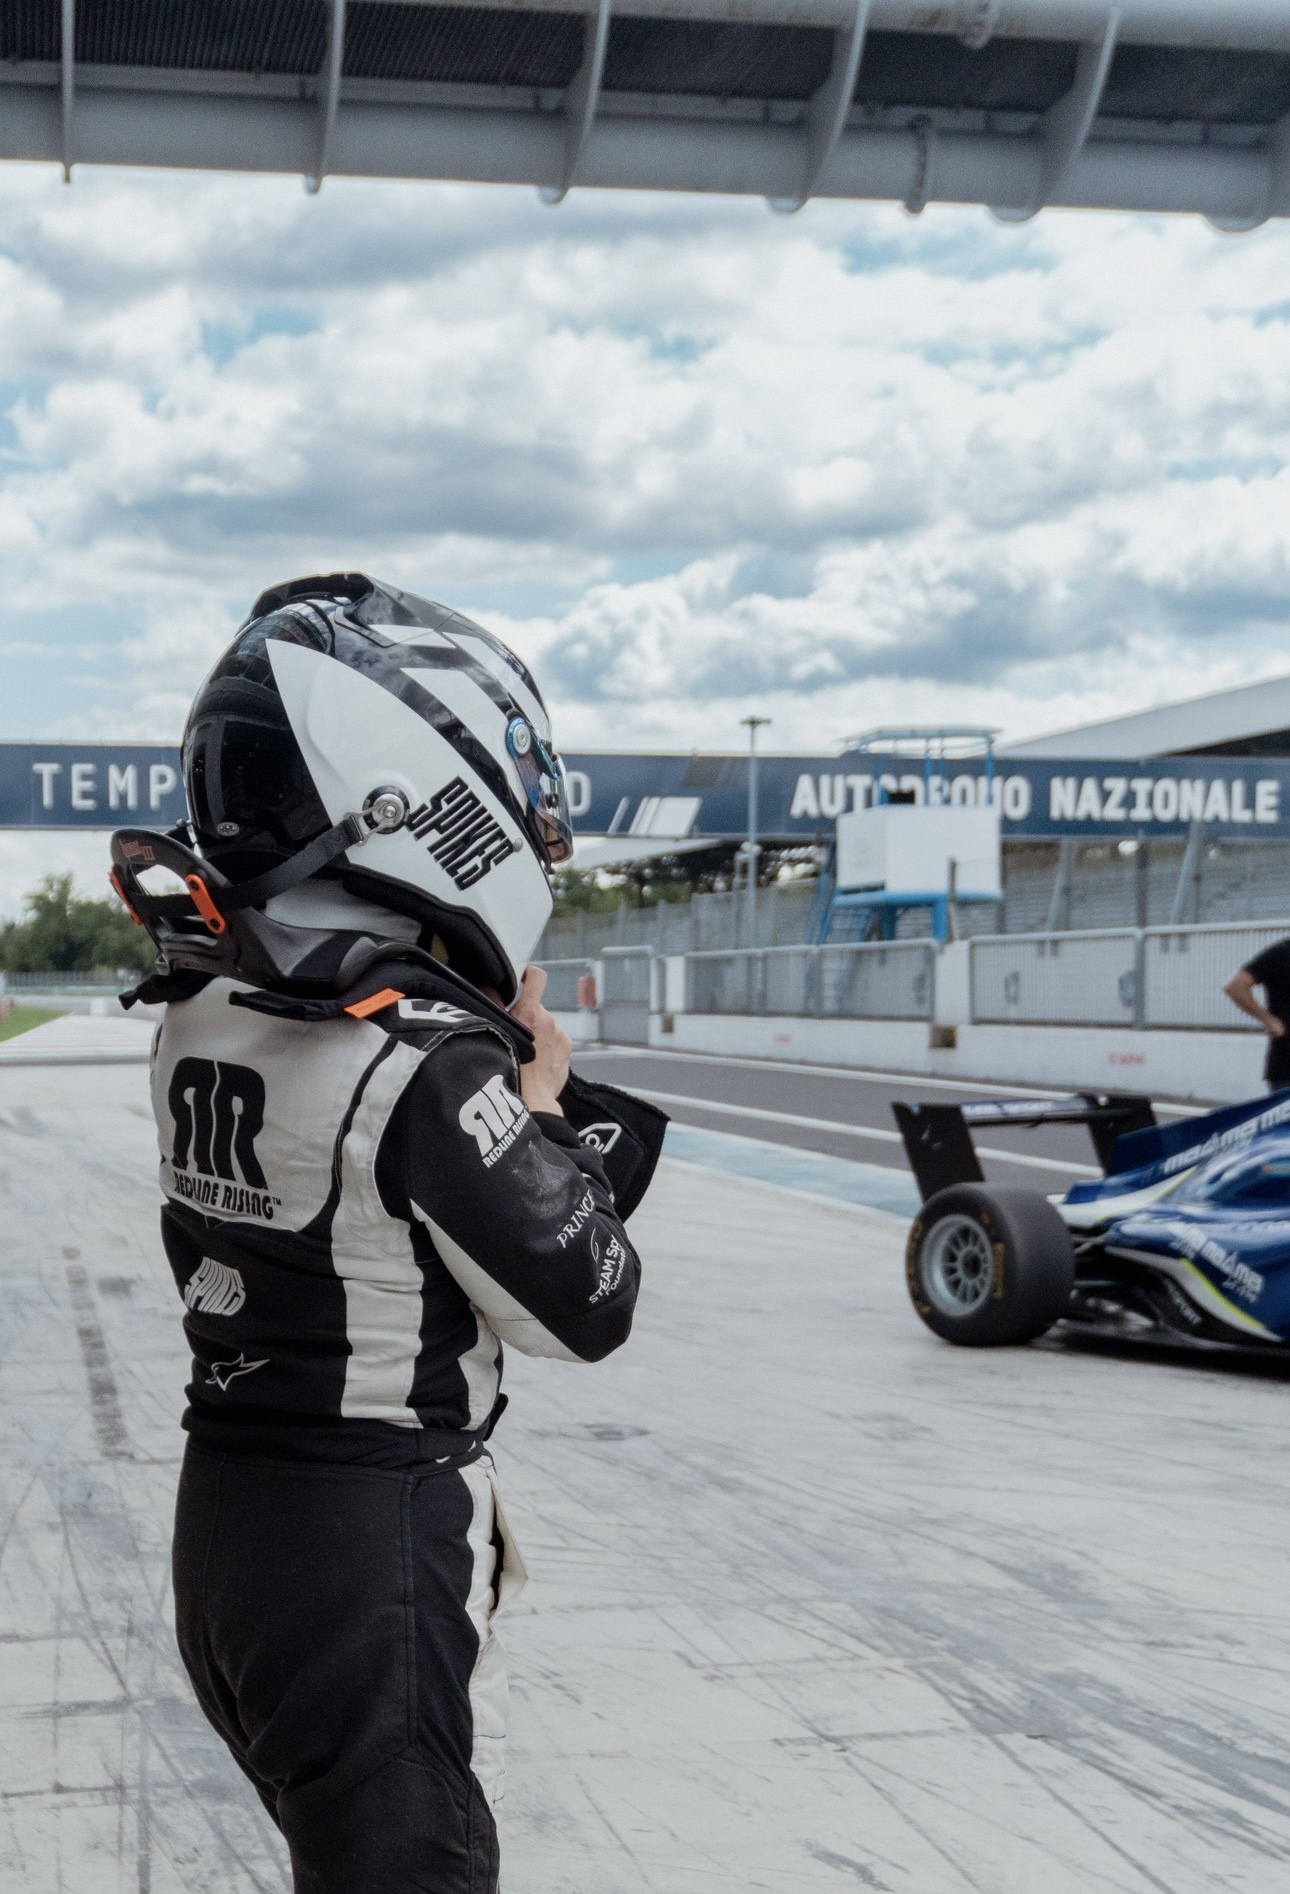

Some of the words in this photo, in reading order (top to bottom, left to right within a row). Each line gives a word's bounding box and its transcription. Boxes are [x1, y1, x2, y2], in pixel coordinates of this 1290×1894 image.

[1050, 775, 1279, 823] NAZIONALE
[482, 1129, 517, 1169] REDLINE
[173, 1170, 220, 1206] REDLINE
[588, 1258, 616, 1304] STEAM
[606, 1234, 621, 1258] Sp
